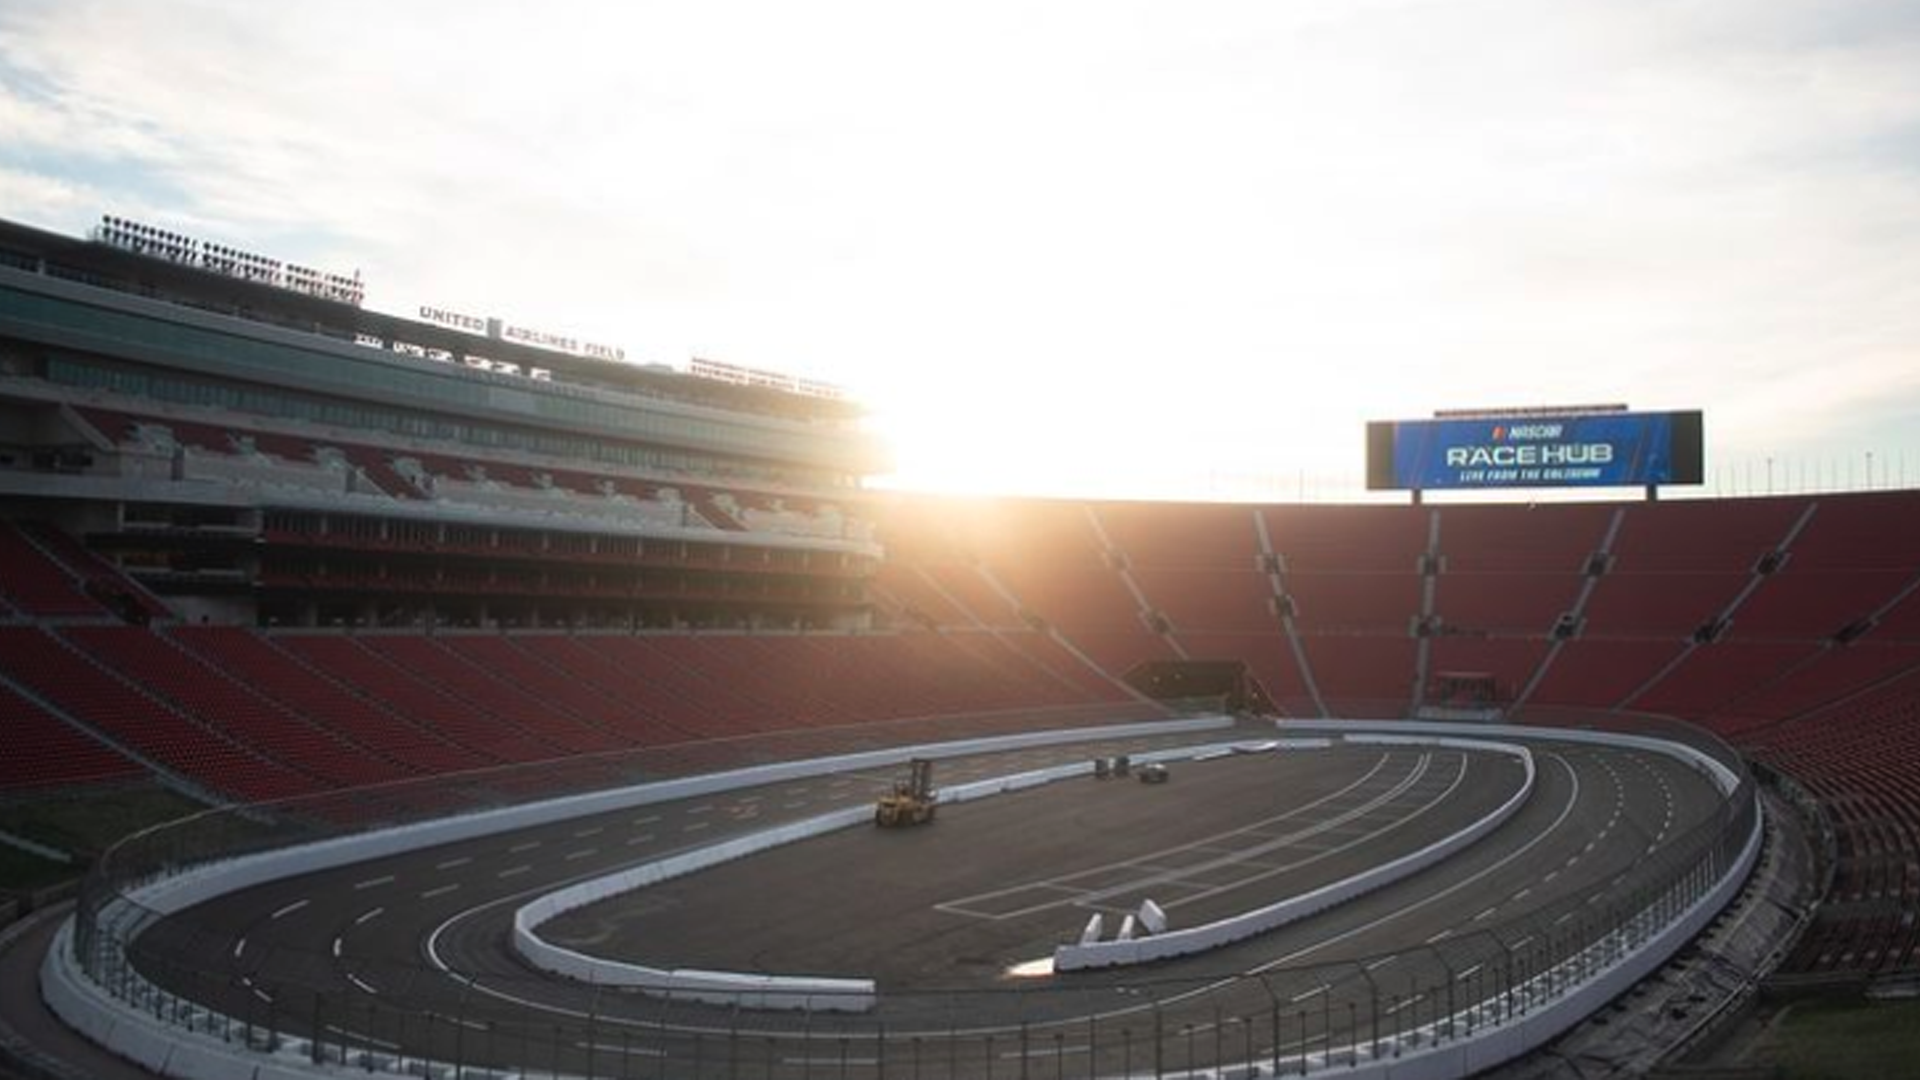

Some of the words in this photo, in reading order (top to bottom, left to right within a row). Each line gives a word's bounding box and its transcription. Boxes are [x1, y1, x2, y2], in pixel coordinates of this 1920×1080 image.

[419, 306, 484, 330] UNITED
[505, 326, 577, 349] AIRLINES
[1447, 446, 1536, 467] RACE
[1542, 443, 1614, 464] HUB
